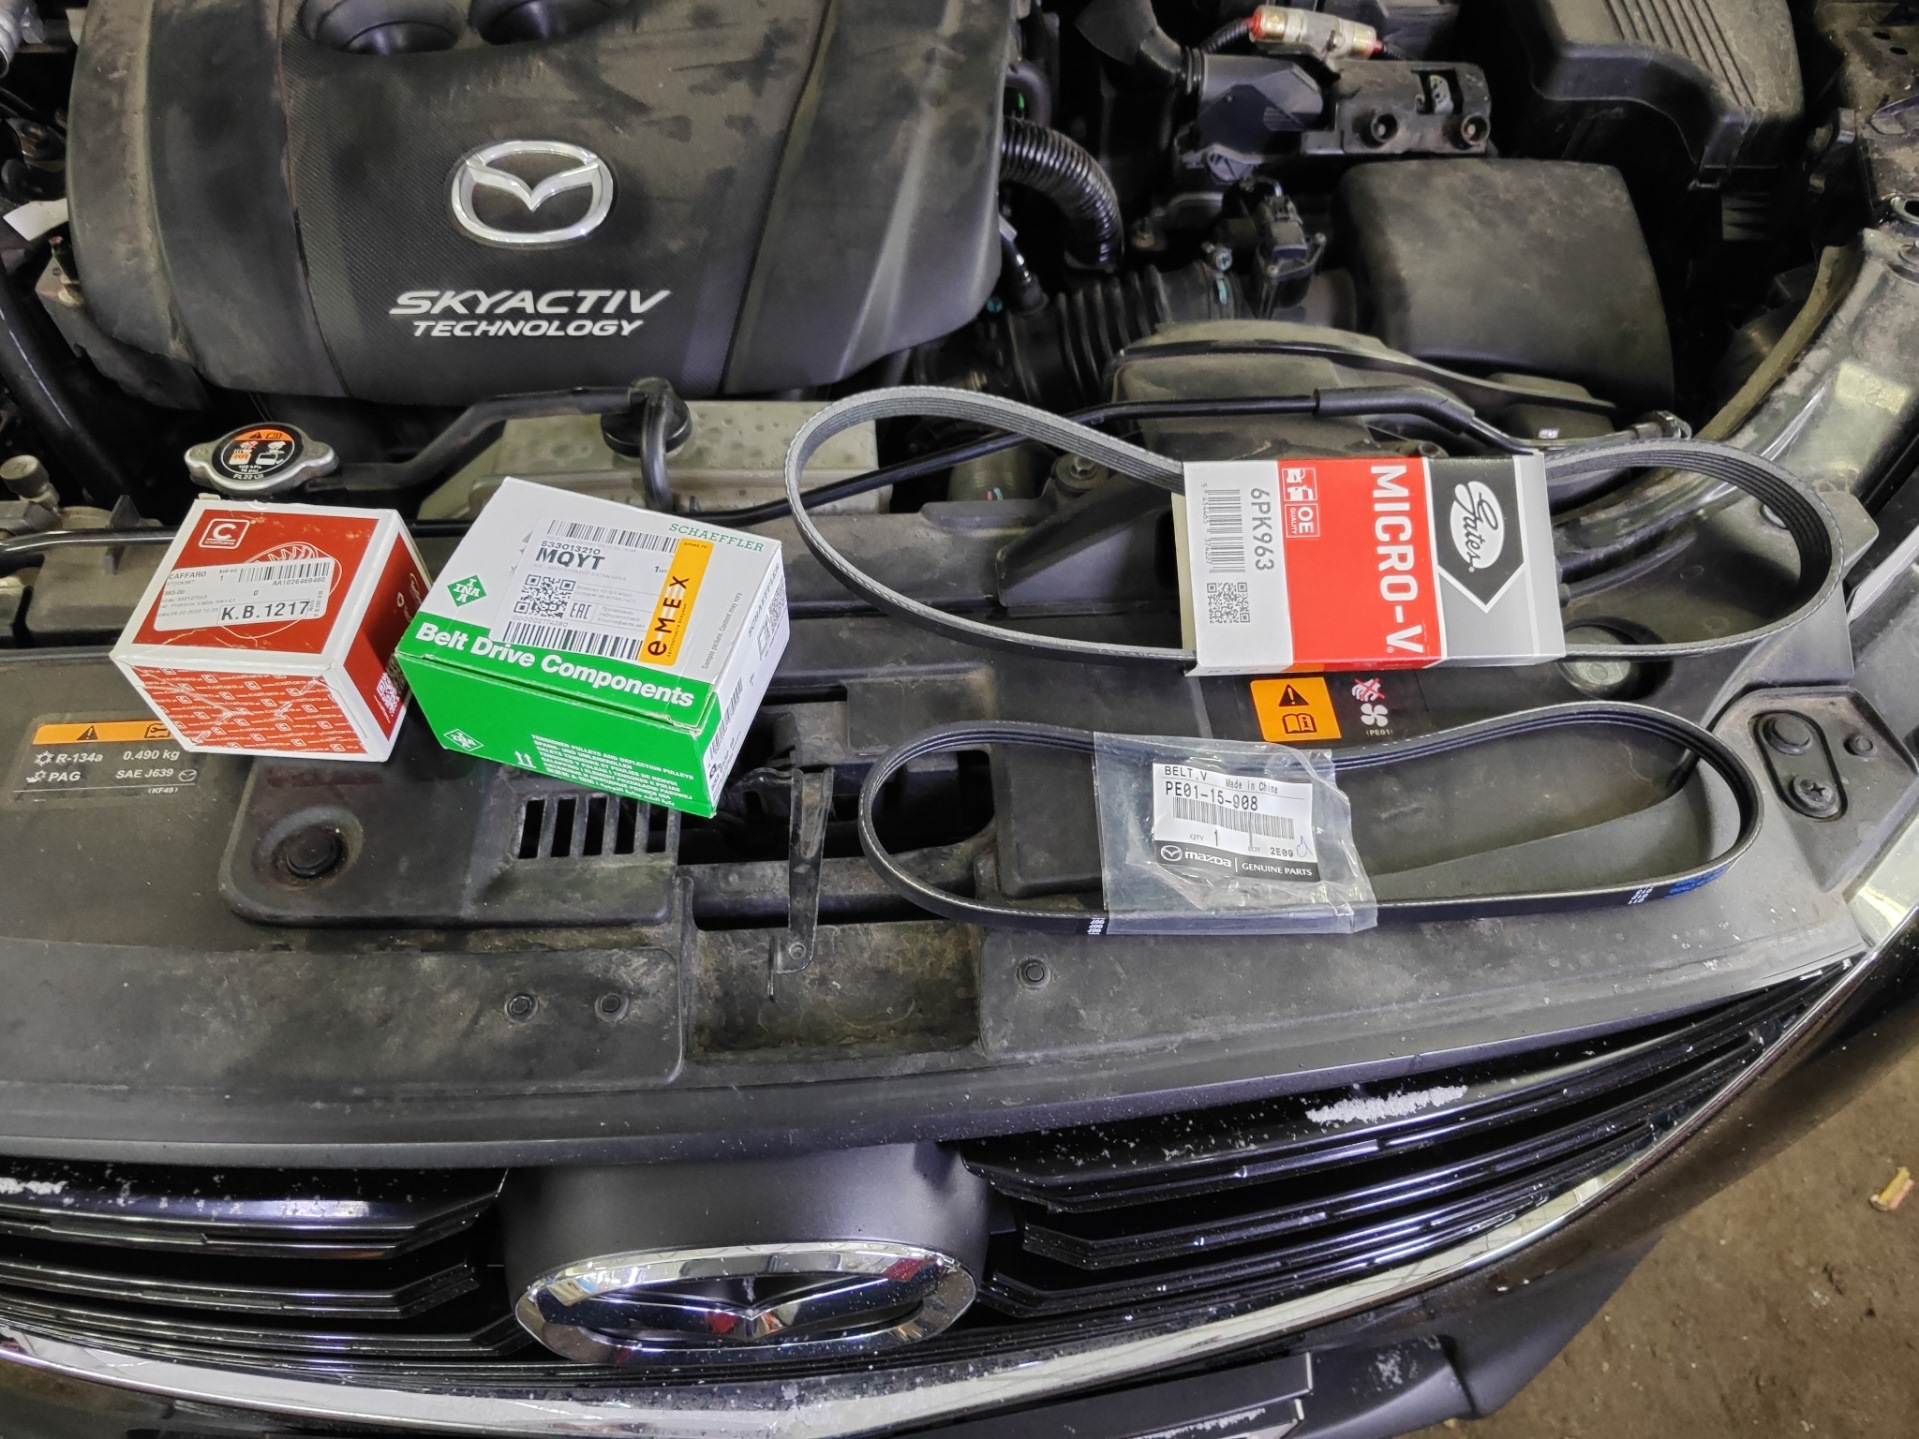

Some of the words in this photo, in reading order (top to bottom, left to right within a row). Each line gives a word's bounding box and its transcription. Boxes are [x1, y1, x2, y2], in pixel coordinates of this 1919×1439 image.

[389, 289, 672, 315] SKYACTIV
[412, 319, 645, 337] TECHNOLOGY
[1250, 487, 1275, 571] 6PK963
[1290, 507, 1298, 535] QUALITY
[1298, 507, 1315, 534] OE
[1454, 482, 1499, 568] Gates
[541, 540, 601, 556] 533013210
[669, 523, 765, 553] SCHAEFFLER
[535, 547, 606, 571] MQYT
[1370, 465, 1424, 654] MICRO-V
[168, 571, 207, 580] CAFFARO
[221, 600, 311, 622] K.B.1217
[415, 621, 469, 651] Belt
[470, 636, 536, 668] Drive
[541, 654, 695, 707] Components
[55, 751, 103, 764] R-134a
[123, 750, 159, 761] 0.490
[162, 749, 180, 761] kg
[48, 771, 81, 782] PAG
[115, 769, 142, 779] SAE
[144, 768, 174, 778] J639
[1225, 778, 1243, 790] Made
[1247, 780, 1256, 791] in
[1258, 781, 1278, 795] China
[1165, 781, 1259, 812] PE01-15-908
[1189, 833, 1205, 842] QTY
[1213, 829, 1219, 847] 1
[1184, 847, 1232, 868] mazda
[1241, 862, 1283, 874] GENUINE
[1284, 867, 1313, 876] PARTS
[1270, 846, 1294, 858] 2E09
